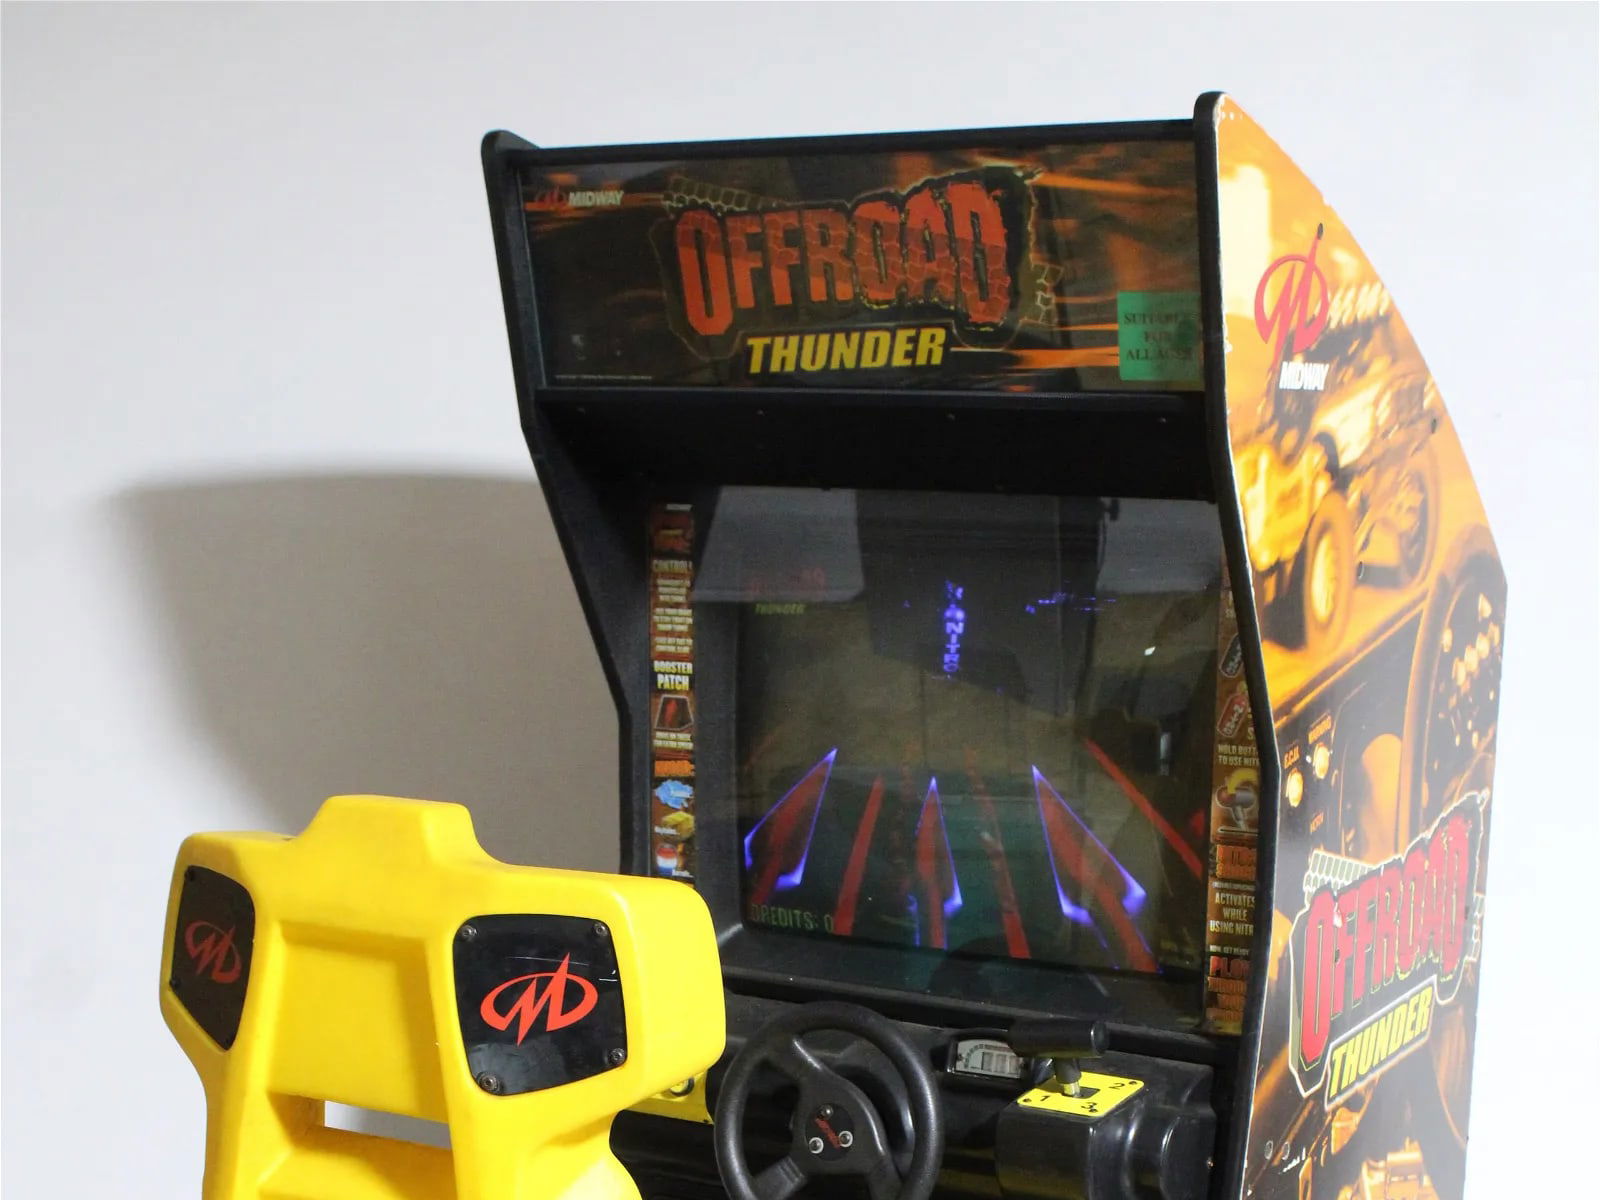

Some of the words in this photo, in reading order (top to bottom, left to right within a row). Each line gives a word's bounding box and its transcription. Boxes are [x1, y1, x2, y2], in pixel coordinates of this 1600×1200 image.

[568, 190, 625, 207] MIDWAY
[675, 182, 1011, 336] OFFROAD
[746, 326, 948, 374] THUNDER
[1127, 348, 1152, 361] ALL
[1279, 361, 1330, 391] MIDWAY
[653, 661, 693, 674] BOOSTER
[657, 674, 690, 691] PATCH
[1222, 906, 1248, 921] WHILE
[1208, 920, 1234, 934] USING
[1300, 811, 1472, 1071] OFFROAD
[1330, 984, 1433, 1098] THUNDER
[1108, 1082, 1126, 1090] 2
[1081, 1101, 1098, 1110] 3
